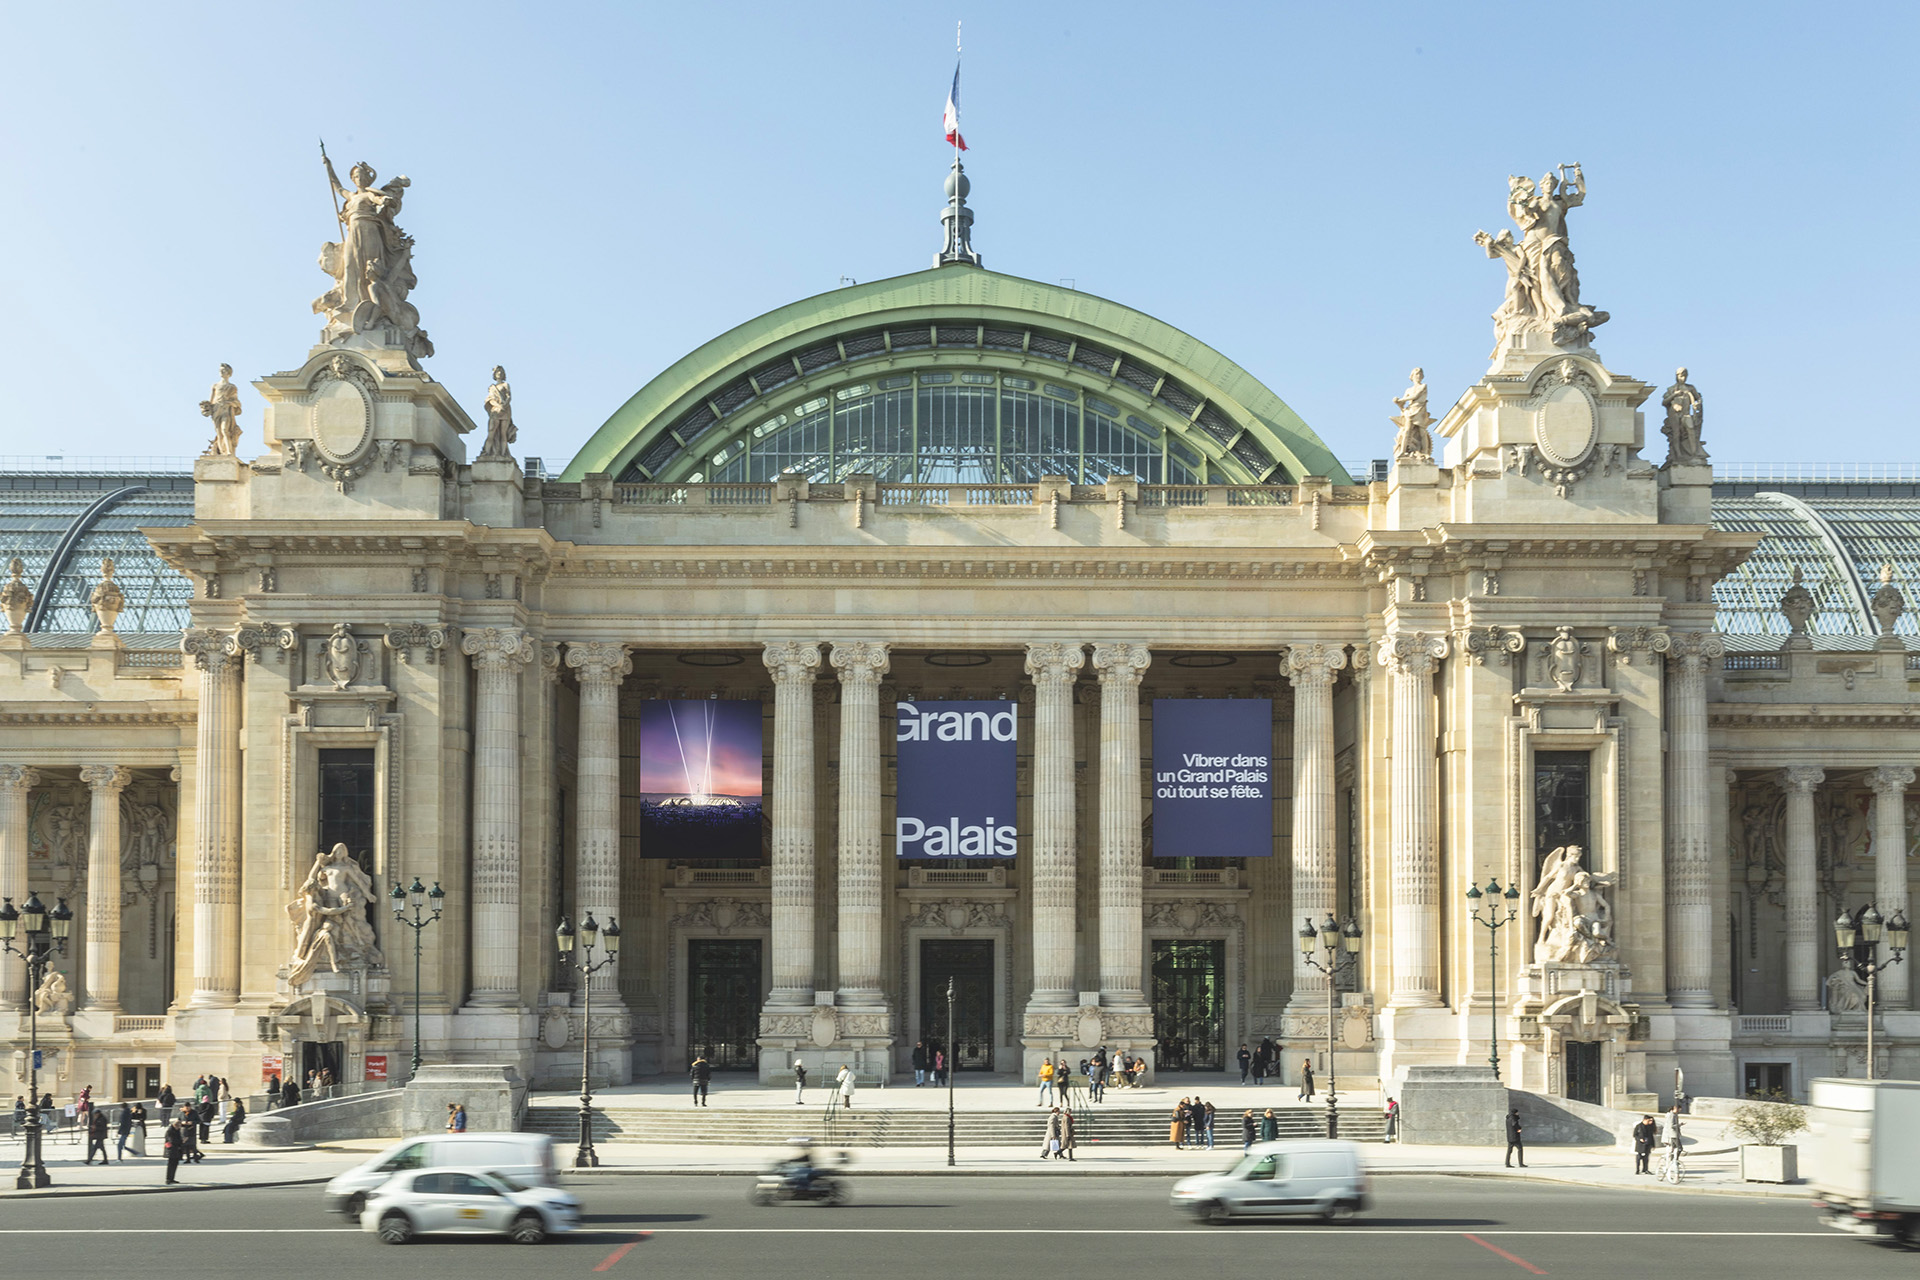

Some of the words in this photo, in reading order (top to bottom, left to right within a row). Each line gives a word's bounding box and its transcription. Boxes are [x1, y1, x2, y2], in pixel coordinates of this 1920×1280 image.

[897, 702, 1017, 742] Grand
[1183, 753, 1230, 767] Vibrer
[1230, 753, 1268, 767] dans
[1156, 771, 1176, 783] un
[1177, 768, 1224, 783] Grand
[1225, 769, 1268, 783] Palais
[1156, 784, 1177, 799] où
[1178, 785, 1209, 799] tout
[1209, 787, 1229, 799] se
[1230, 784, 1263, 799] fête.
[896, 817, 1017, 856] Palais
